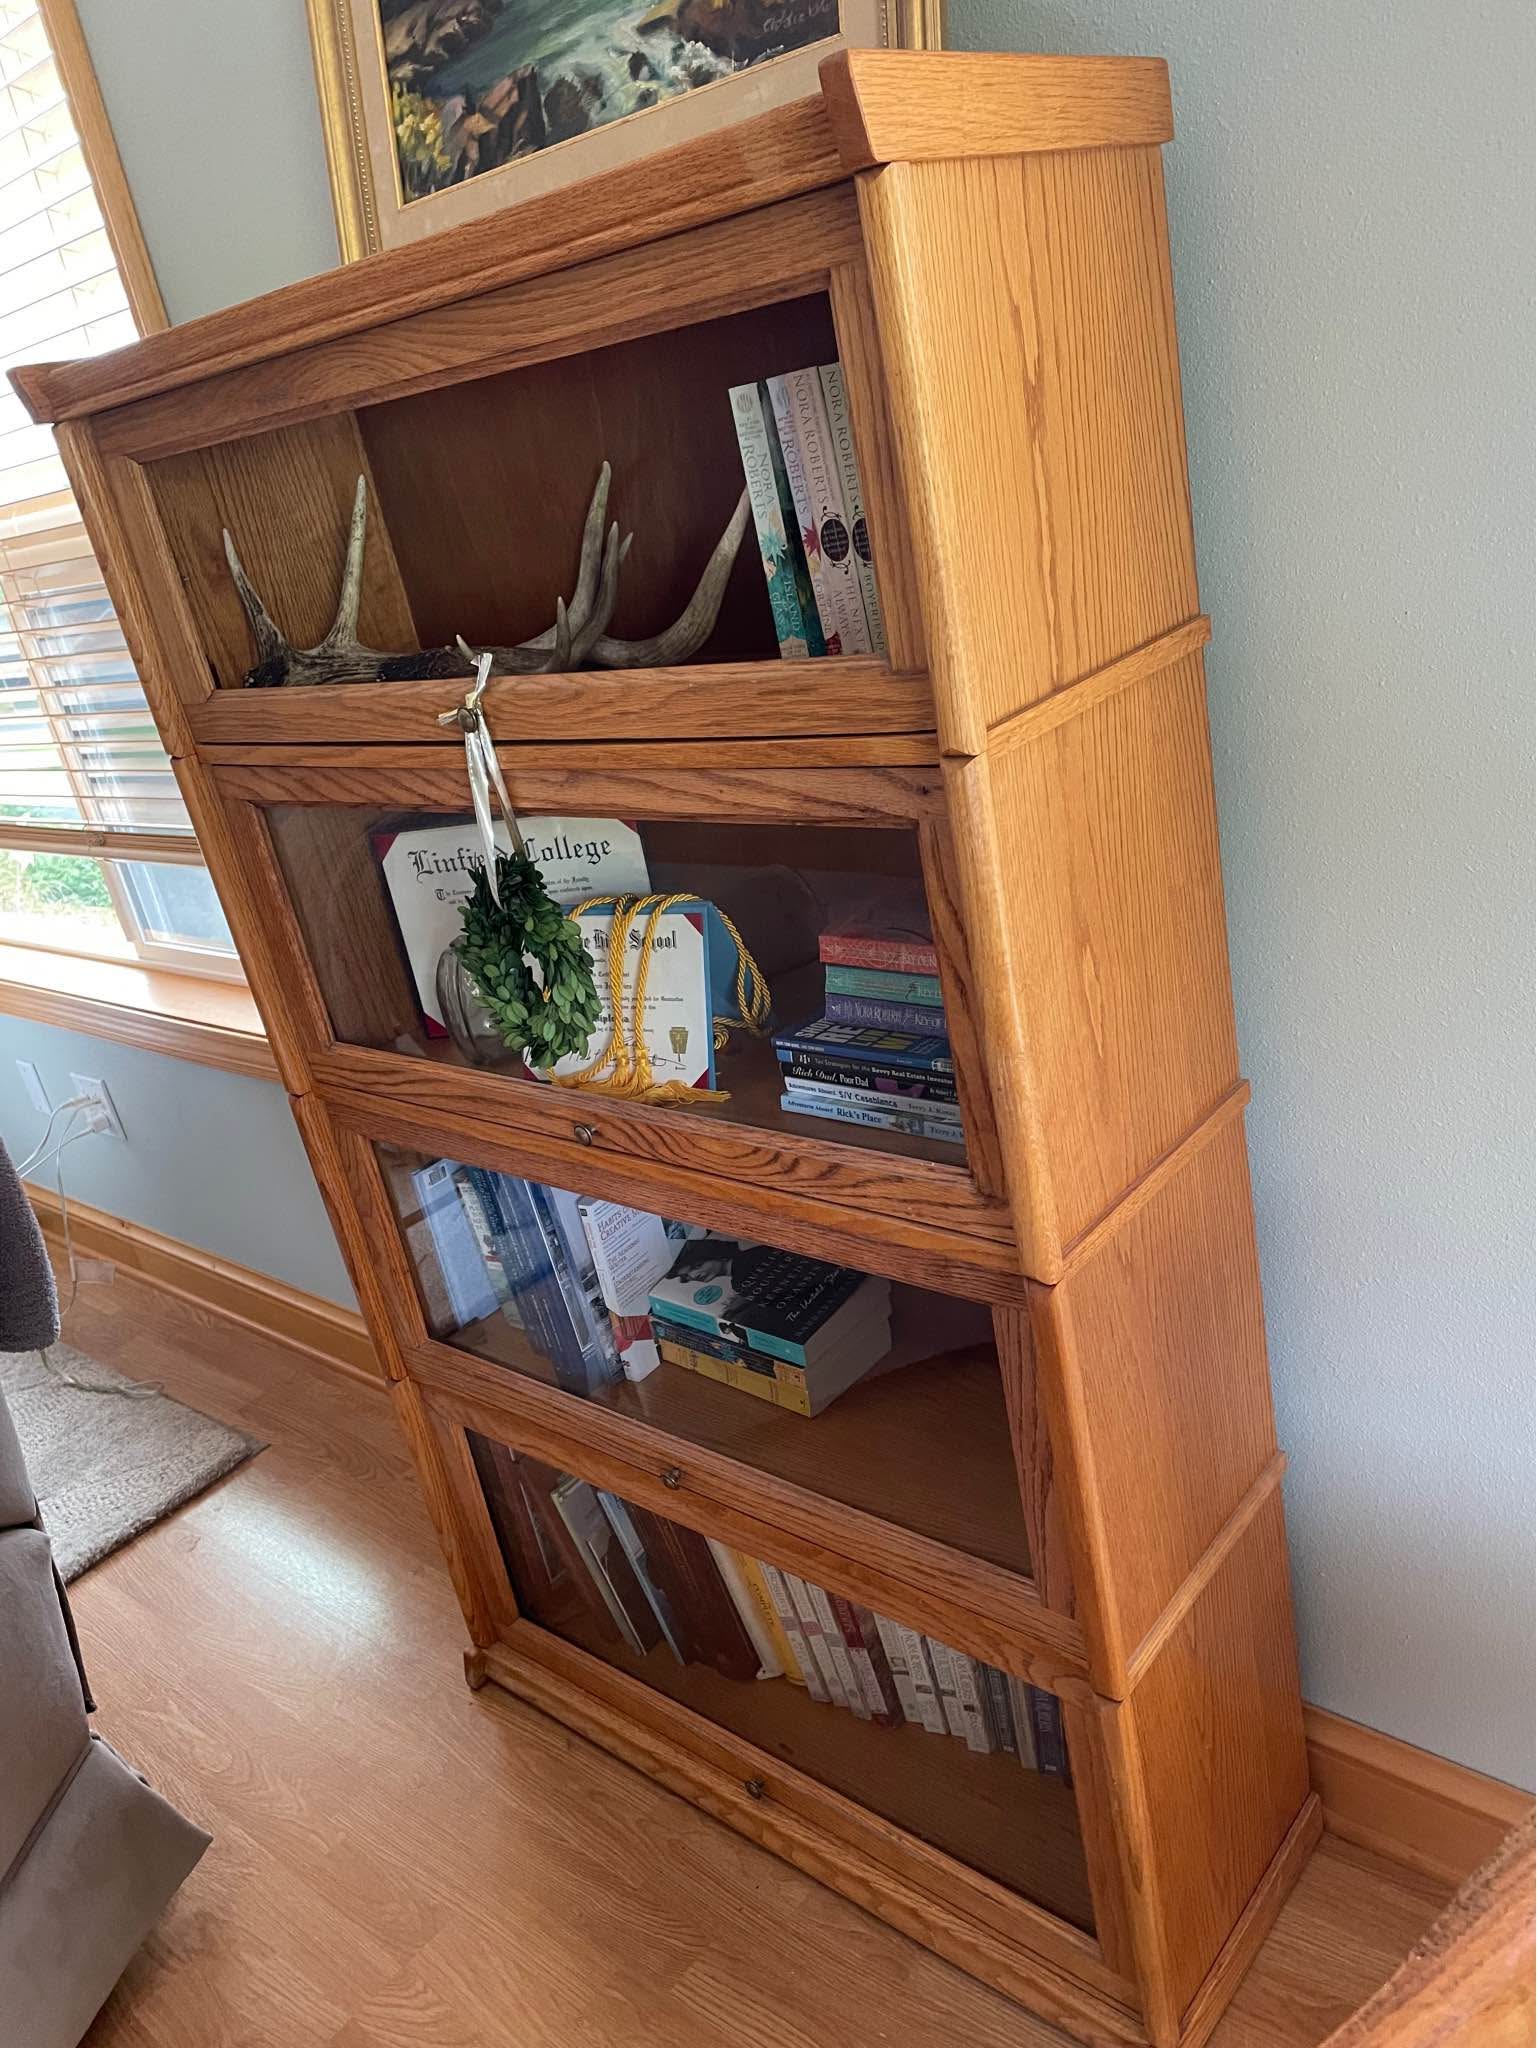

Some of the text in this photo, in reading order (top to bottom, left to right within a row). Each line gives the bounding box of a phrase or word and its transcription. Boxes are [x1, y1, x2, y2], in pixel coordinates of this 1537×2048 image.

[793, 374, 828, 505] NORA ROBERTS
[826, 370, 860, 504] NORA ROBERTS
[742, 442, 768, 520] ROBERTS
[757, 452, 775, 507] NORA
[782, 438, 809, 515] ROBERTS
[783, 580, 800, 632] ISLAND
[407, 834, 613, 884] Linfied College
[792, 1066, 813, 1078] Rich
[839, 1074, 854, 1084] Poor
[855, 1077, 869, 1088] Dad
[891, 1070, 905, 1078] Real
[906, 1072, 926, 1081] Estate
[837, 1107, 860, 1119] Rick's
[862, 1112, 882, 1123] Place
[854, 1094, 898, 1108] Casablanca
[597, 1211, 622, 1233] HABITS
[600, 1214, 632, 1241] CREATIVE
